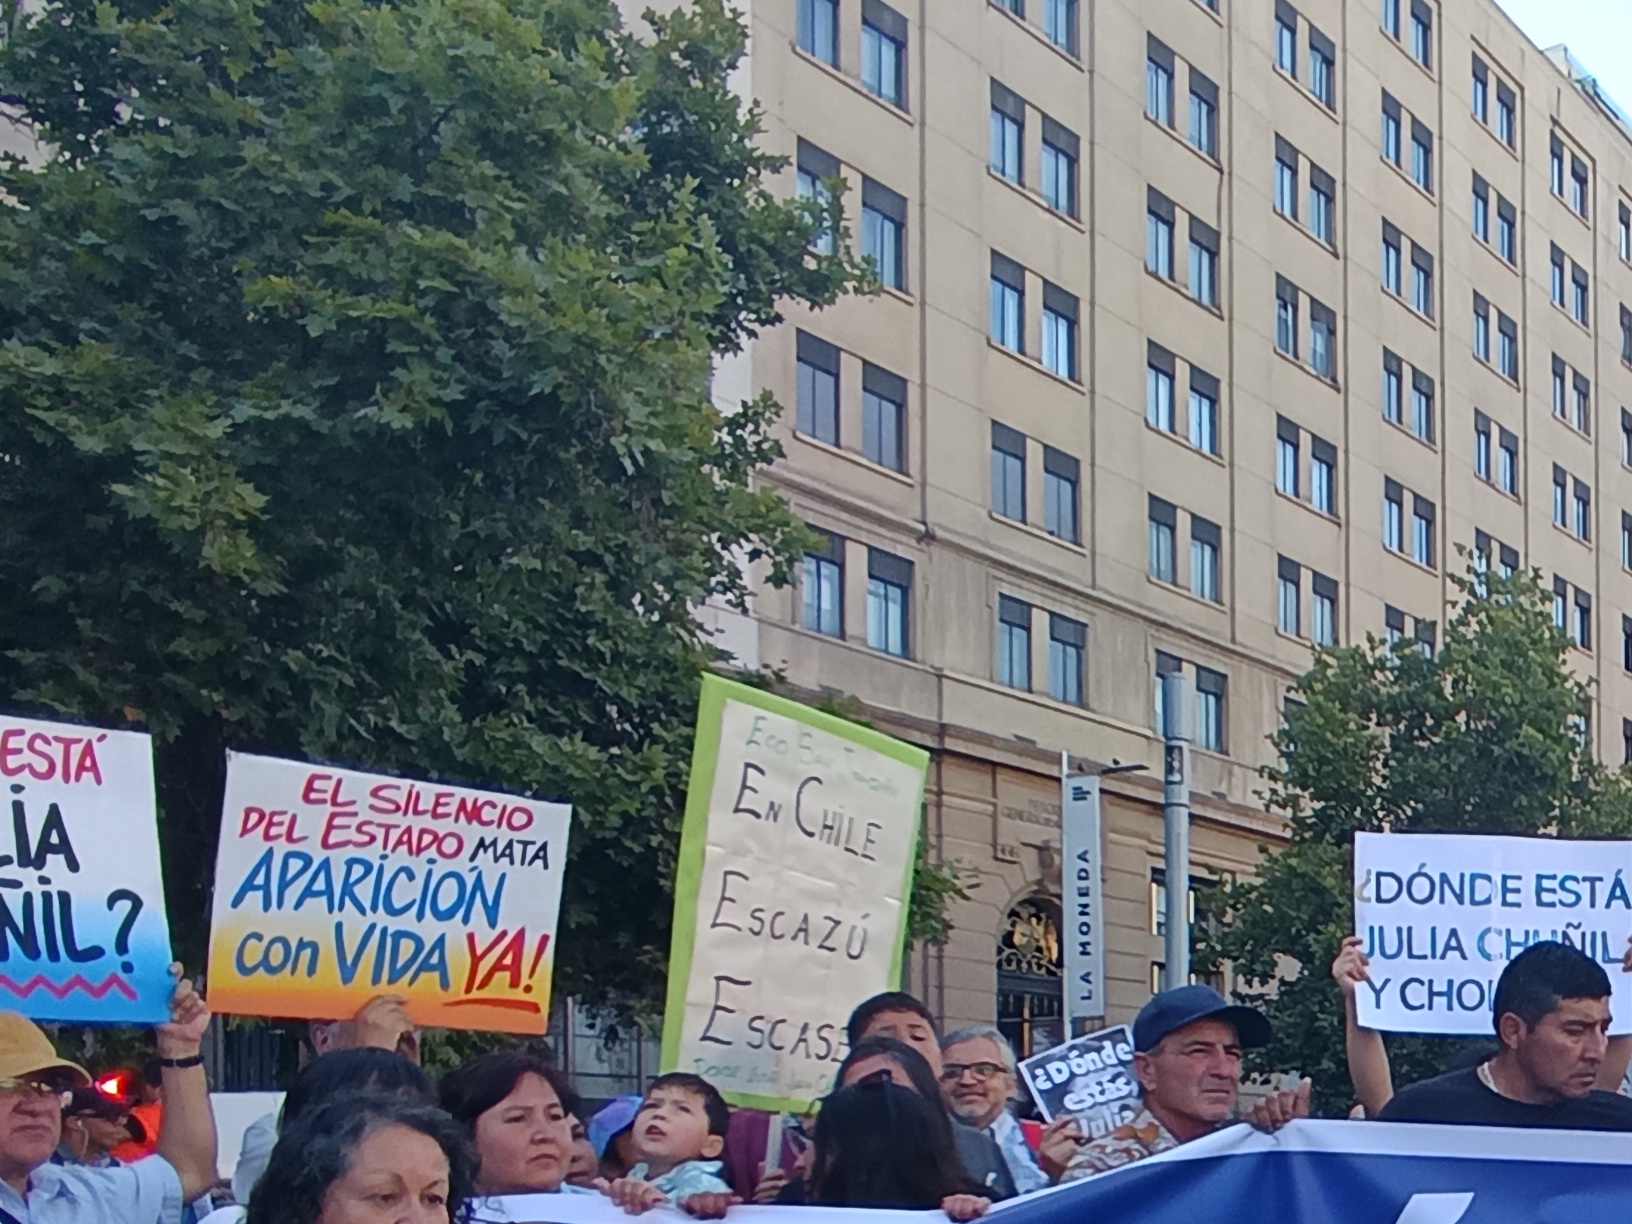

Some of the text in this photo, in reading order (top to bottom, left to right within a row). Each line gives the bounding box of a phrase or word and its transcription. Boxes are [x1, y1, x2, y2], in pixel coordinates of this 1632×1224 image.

[1, 728, 108, 786] ESTÁ
[301, 773, 534, 832] EL SILENCIO
[239, 807, 549, 870] DEL ESTADO MATA
[1357, 862, 1632, 910] ¿DÓNDE ESTÁ
[1077, 849, 1093, 1001] LA MONEDA
[1365, 925, 1468, 961] JULIA
[235, 921, 550, 995] con VIDA YA!
[1365, 977, 1494, 1012] Y CHO
[1034, 1040, 1134, 1090] ¿Dónde
